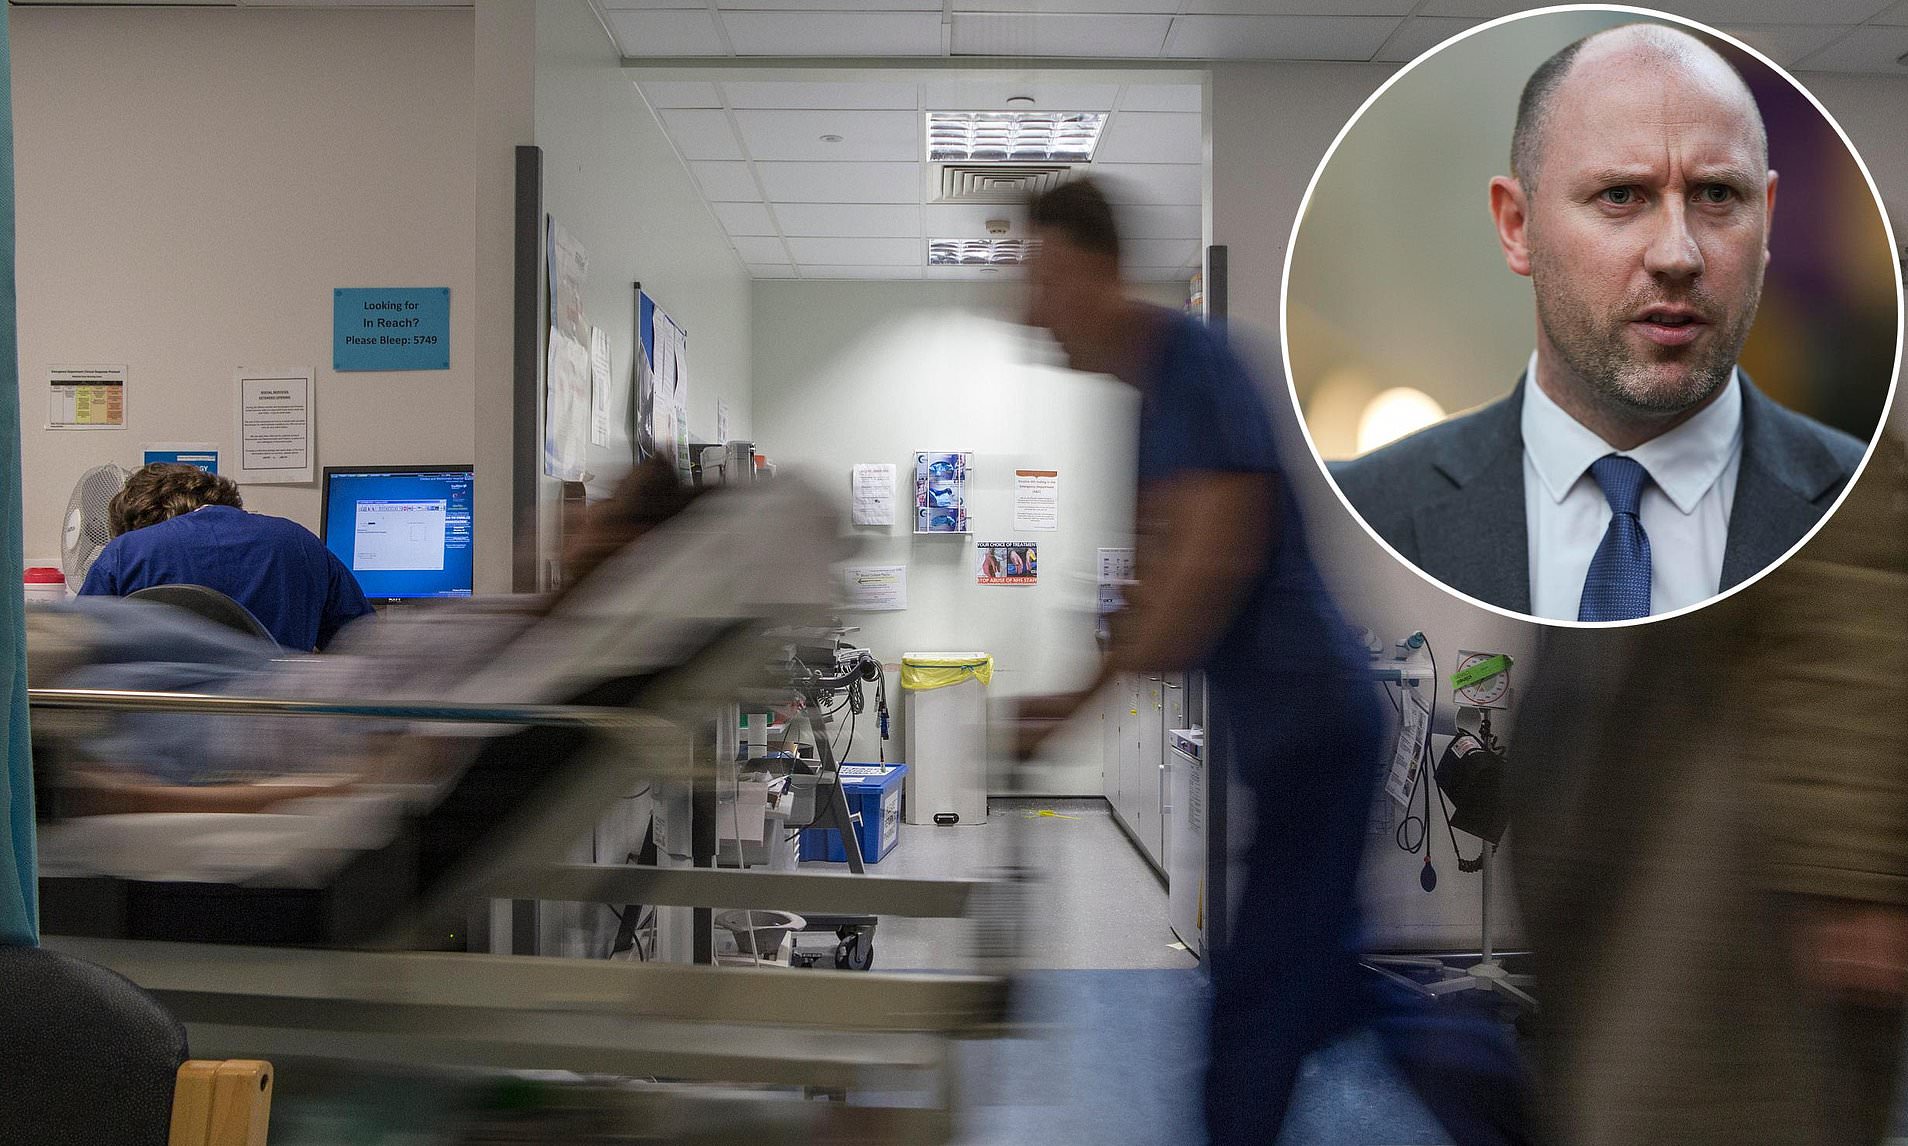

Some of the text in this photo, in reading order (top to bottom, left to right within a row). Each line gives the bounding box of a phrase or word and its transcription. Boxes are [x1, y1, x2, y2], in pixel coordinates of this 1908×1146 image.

[364, 301, 419, 312] Looking for
[363, 318, 420, 328] In Reach?
[345, 335, 438, 346] Please Bleep: 5749
